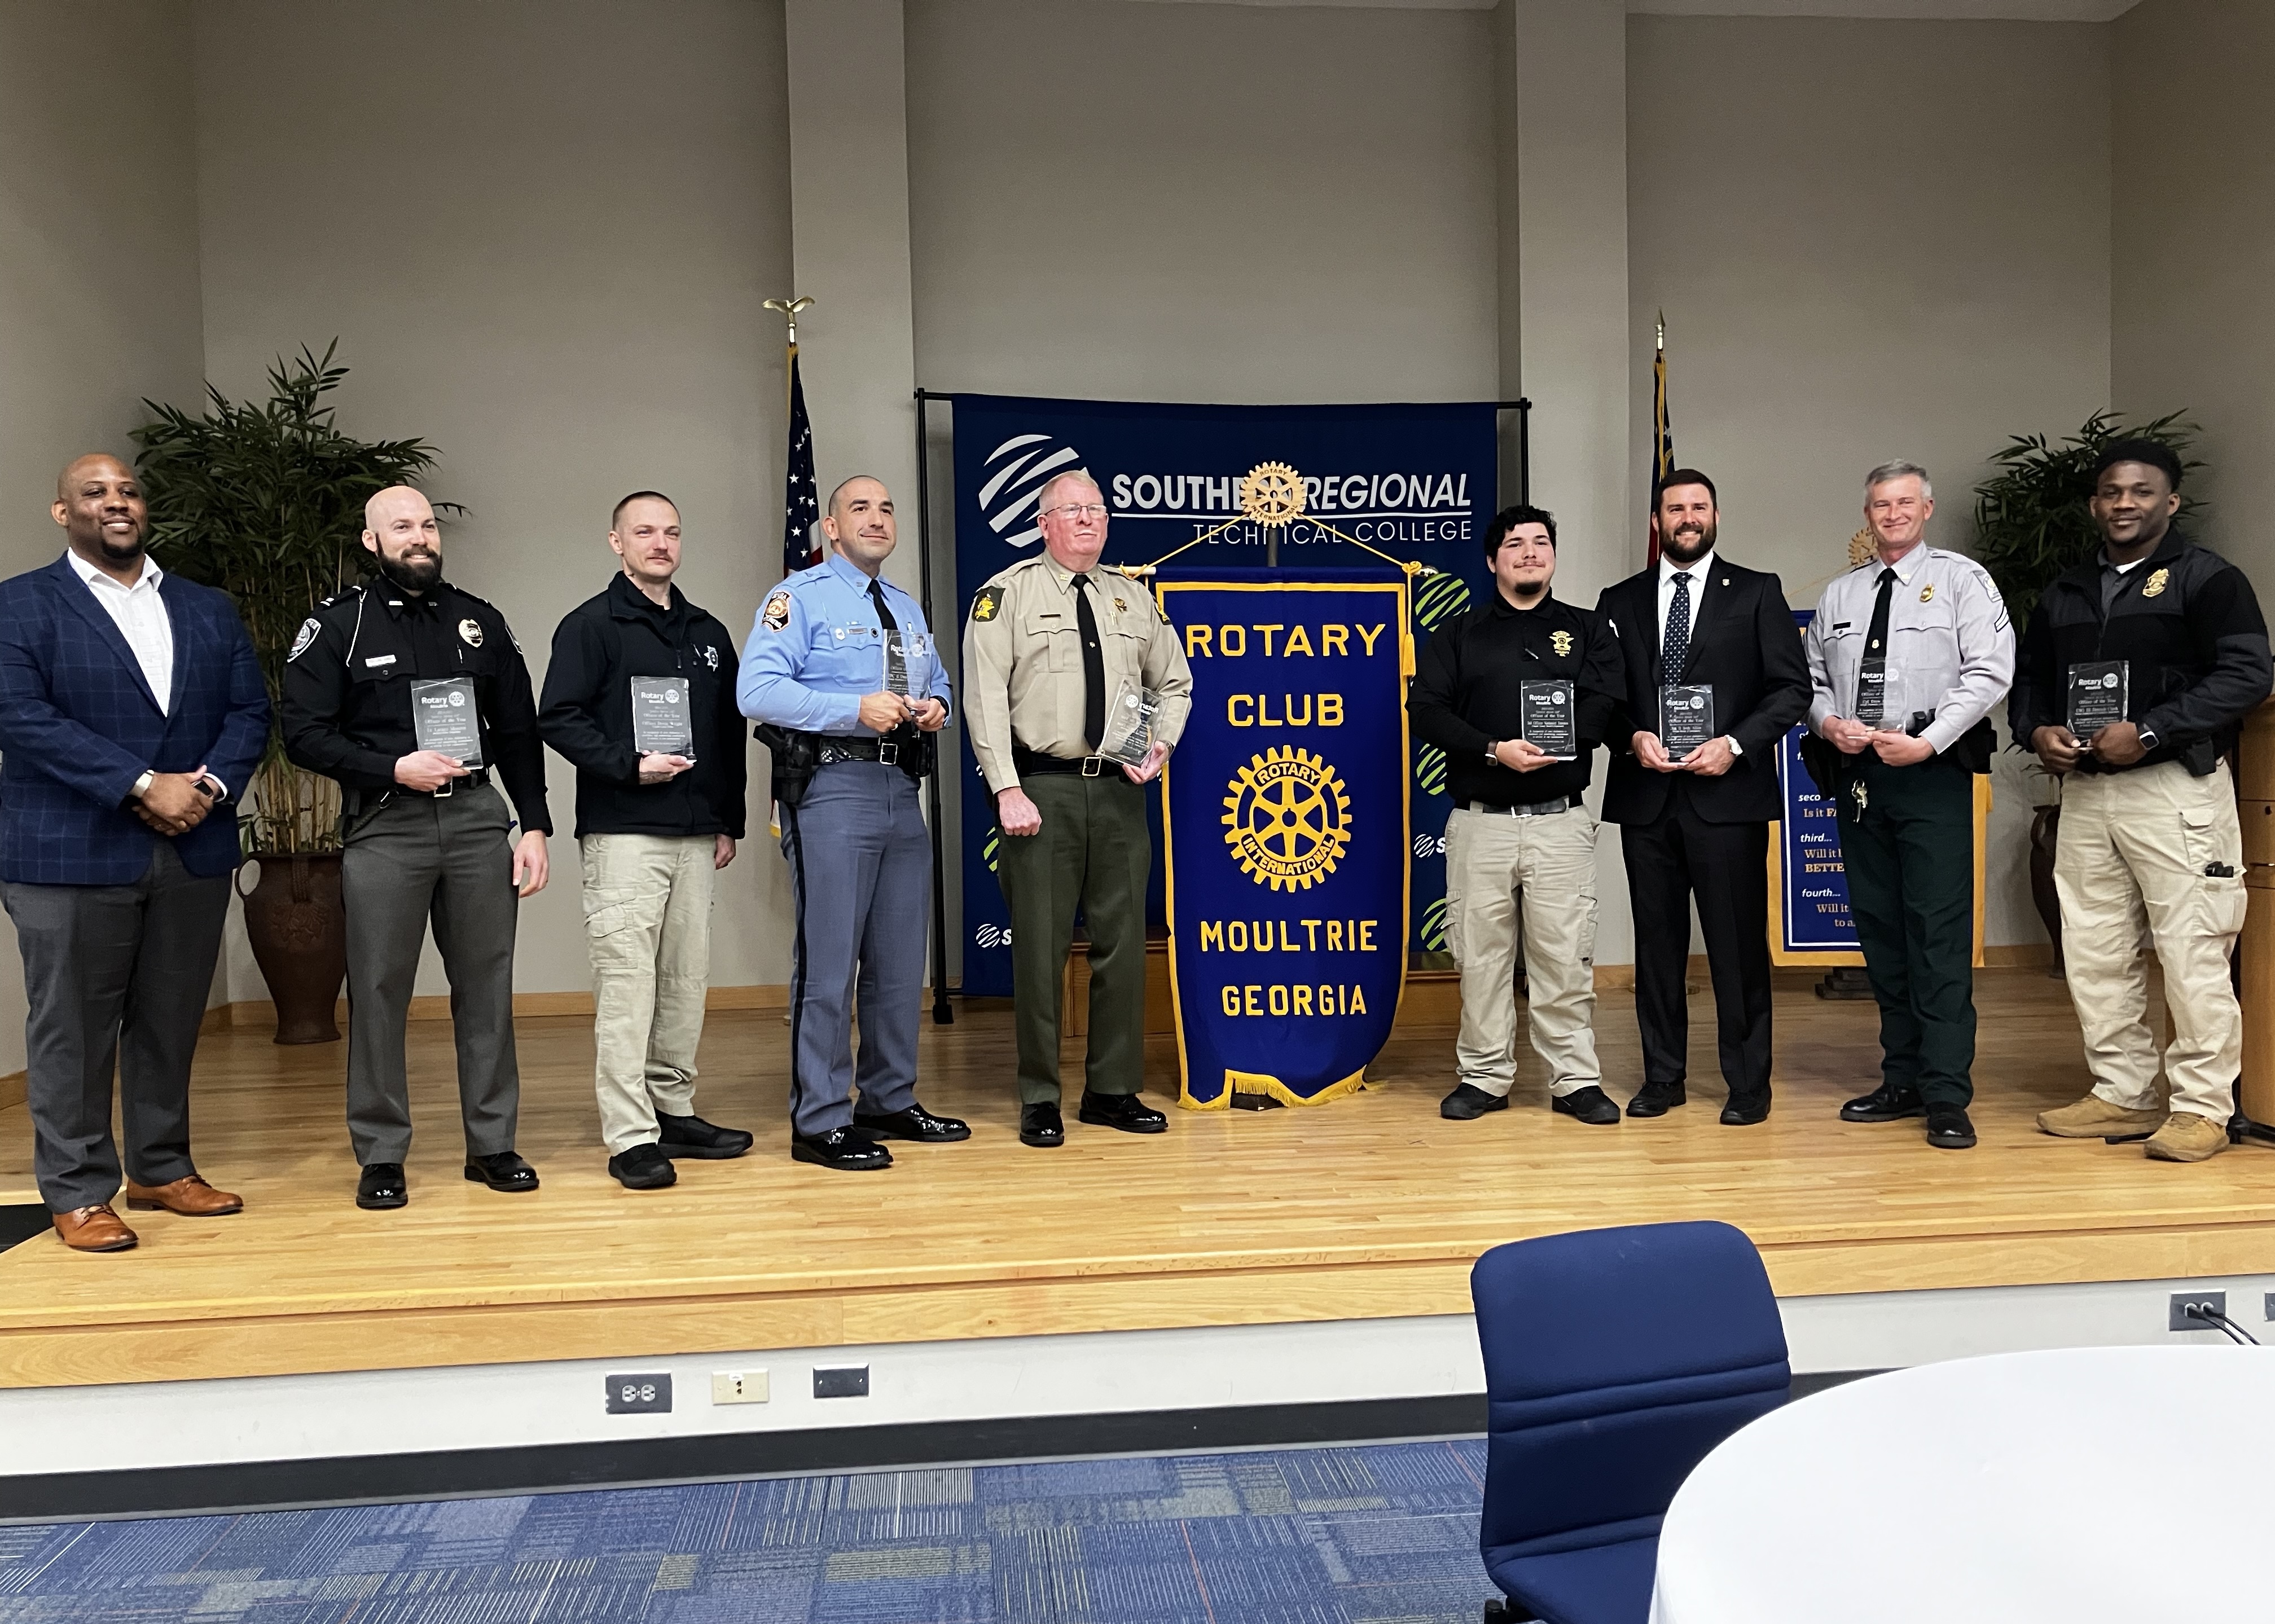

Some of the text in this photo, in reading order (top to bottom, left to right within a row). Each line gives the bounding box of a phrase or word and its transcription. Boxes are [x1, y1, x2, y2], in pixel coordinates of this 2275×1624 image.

[1113, 473, 1471, 510] SOUTHE REGIONAL
[1251, 504, 1298, 521] INTERNATIONAL
[1355, 521, 1472, 542] COLLEGE
[1187, 623, 1386, 657] ROTARY
[641, 692, 664, 701] Rotary
[1228, 693, 1345, 727] CLUB
[1257, 763, 1321, 784] ROTARY
[1803, 808, 1814, 817] Is
[1816, 808, 1824, 817] it
[1800, 833, 1832, 843] third...
[1243, 837, 1334, 875] INTERNATIONAL
[1804, 848, 1837, 859] Will it
[1805, 862, 1844, 873] BETTE
[1802, 888, 1841, 897] fourth...
[1816, 903, 1849, 913] Will it
[1200, 919, 1378, 952] MOULTRIE
[1221, 984, 1367, 1016] GEORGIA
